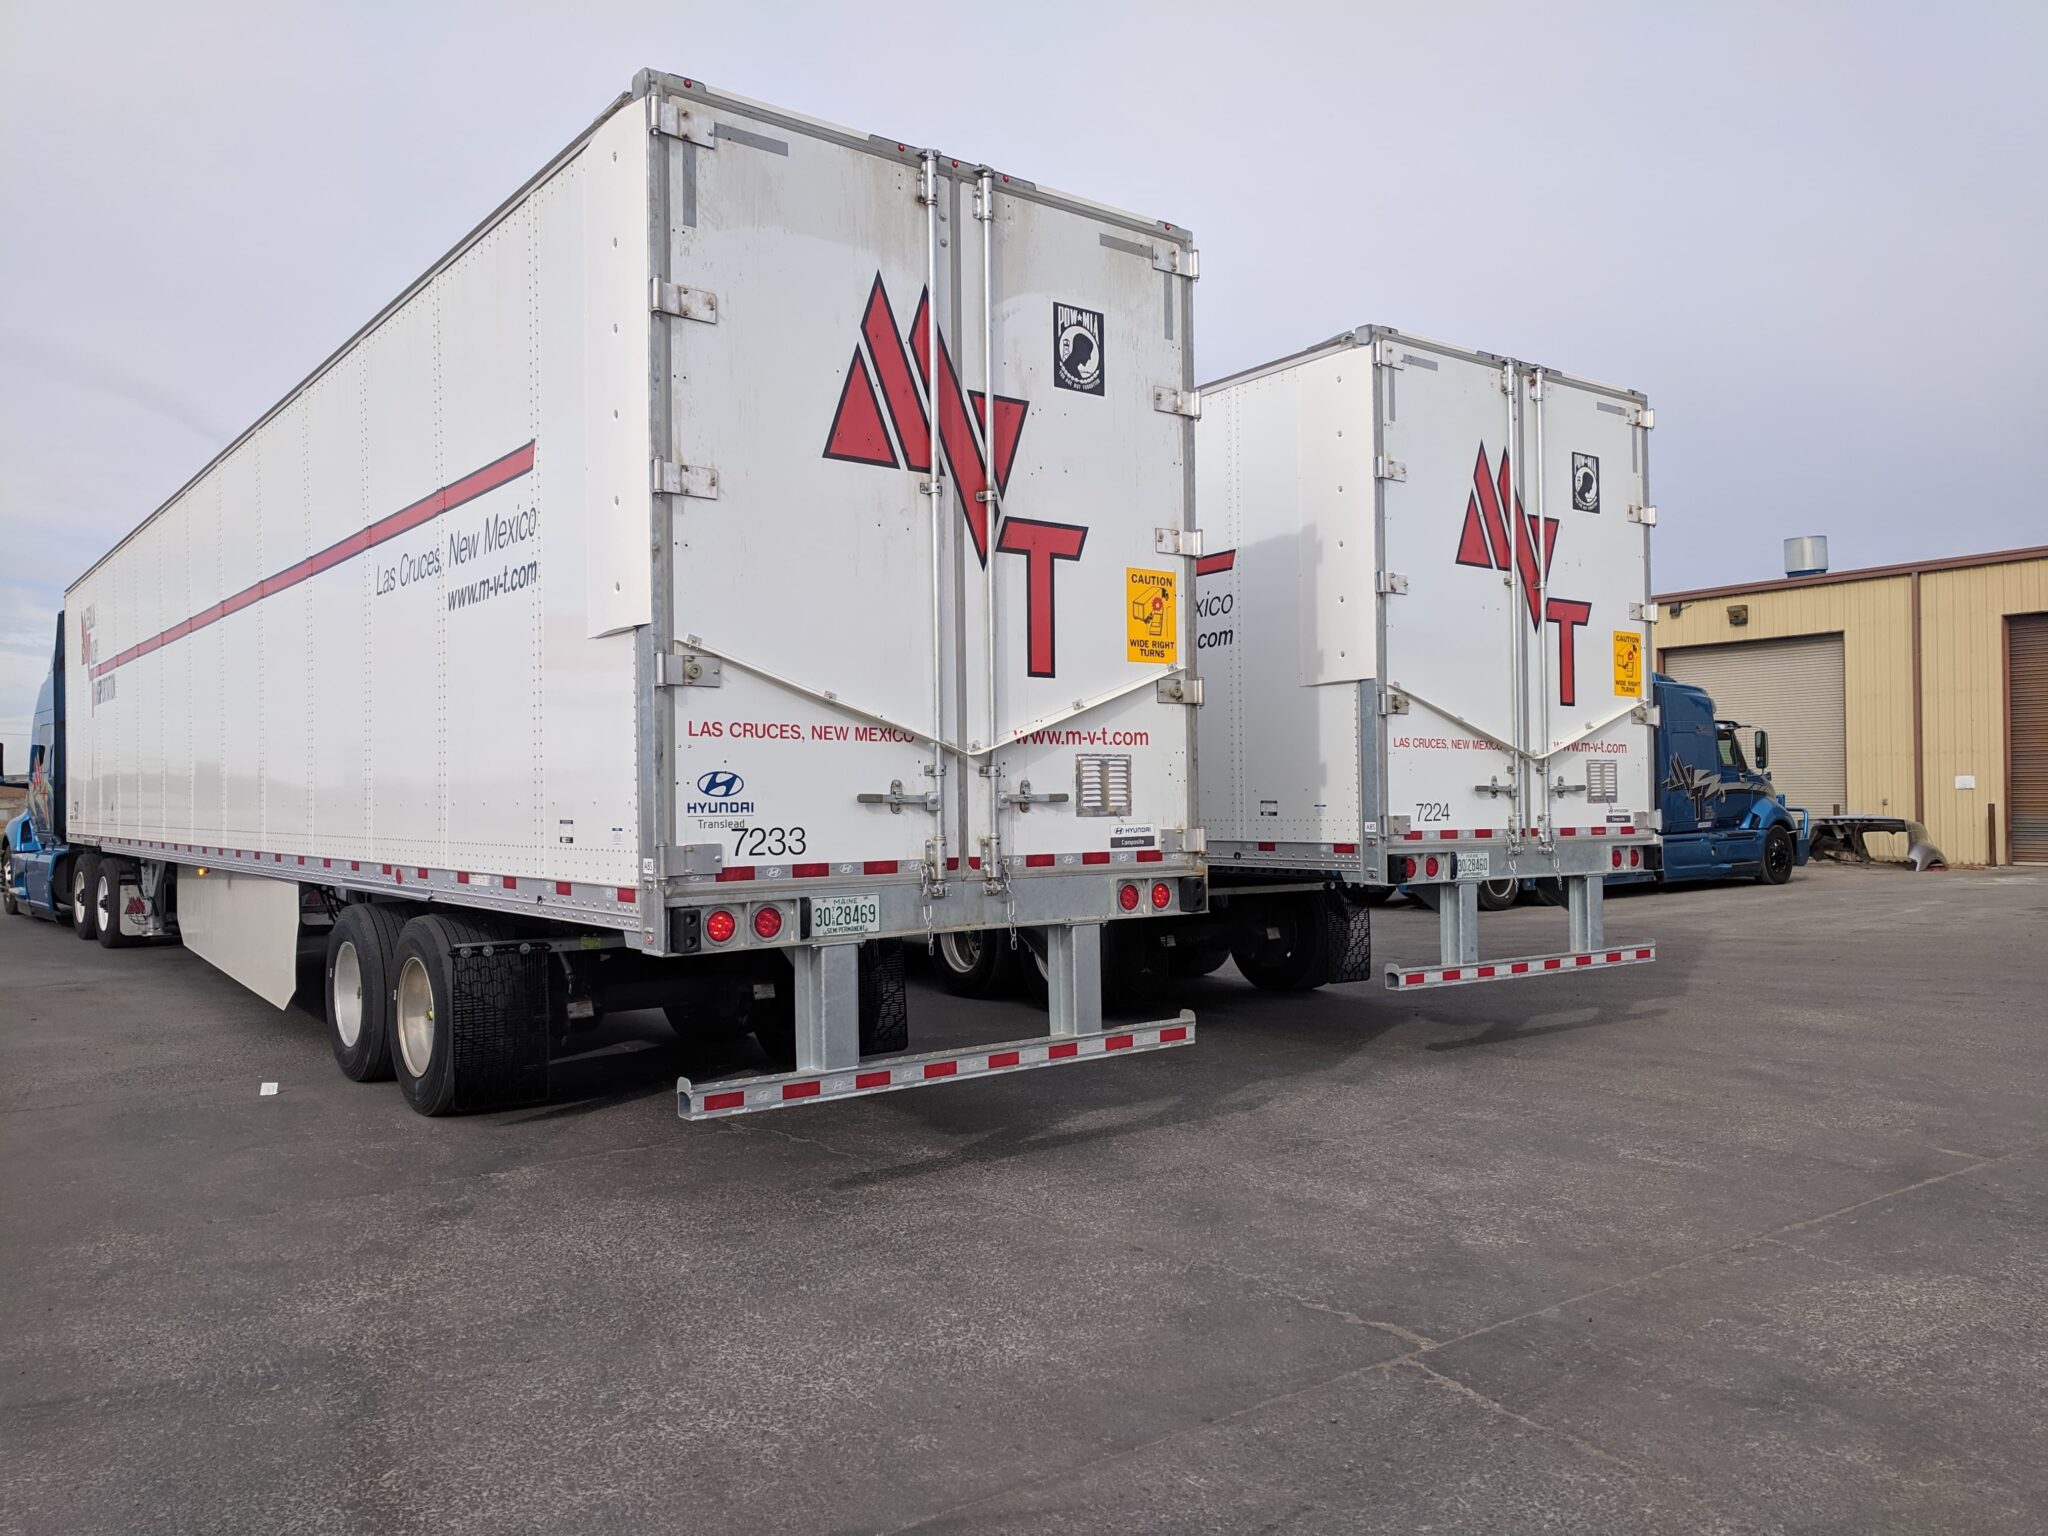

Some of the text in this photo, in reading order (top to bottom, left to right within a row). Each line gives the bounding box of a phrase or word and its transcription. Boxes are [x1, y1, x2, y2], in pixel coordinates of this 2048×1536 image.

[1058, 306, 1100, 346] POW MIA
[376, 504, 537, 596] Las Cruces, New Mexico
[448, 560, 537, 612] www.m-v-t.com
[1131, 573, 1172, 587] CAUTION
[1130, 639, 1174, 649] WIDE RIGHT
[1616, 635, 1639, 643] CAUTION
[1140, 649, 1165, 658] TURNS
[688, 721, 723, 737] LAS
[729, 723, 805, 743] CRUCES,
[811, 726, 849, 741] NEW
[1393, 737, 1410, 748] LAS
[1412, 738, 1449, 750] CRUCES,
[1451, 740, 1470, 750] NEW
[687, 802, 754, 814] HYUNDAI
[1416, 802, 1450, 822] 7224
[698, 819, 745, 829] Translead
[731, 827, 807, 857] 7233
[815, 907, 831, 927] 30
[836, 904, 876, 926] 28469
